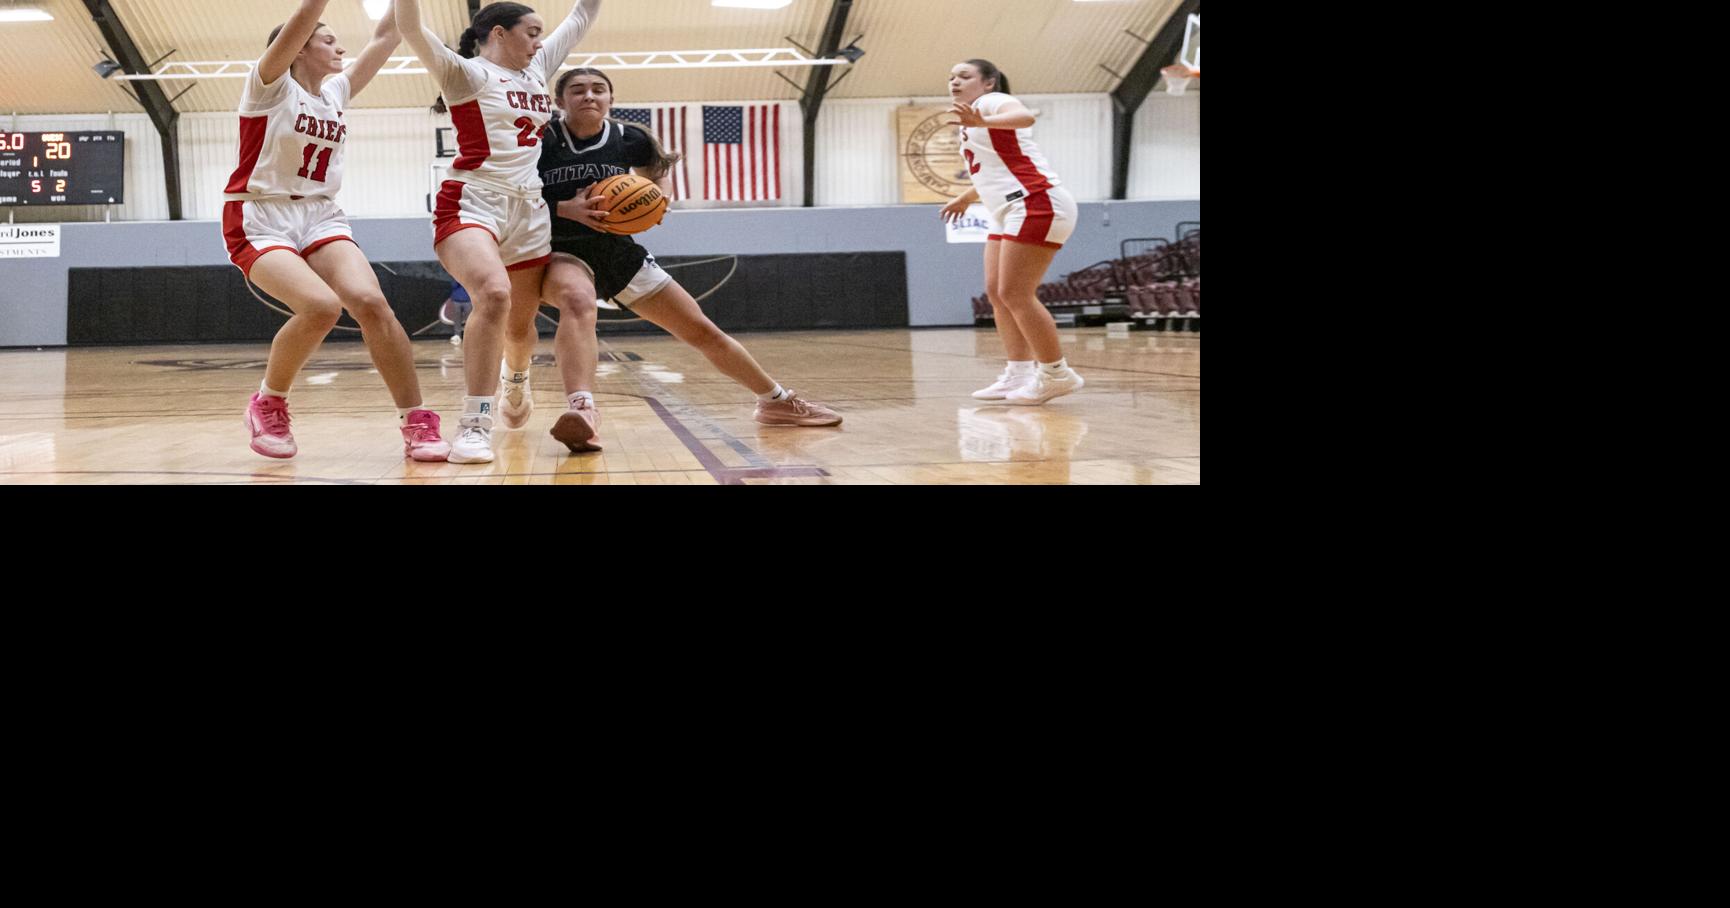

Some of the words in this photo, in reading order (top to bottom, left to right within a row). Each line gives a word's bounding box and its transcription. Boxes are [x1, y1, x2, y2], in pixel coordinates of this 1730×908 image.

[506, 91, 552, 113] CHIEF
[295, 113, 347, 144] CHIEF
[45, 142, 71, 159] 20
[297, 142, 333, 182] 11
[31, 180, 41, 192] 5
[56, 179, 66, 192] 2
[619, 187, 662, 215] Wilson
[15, 228, 55, 238] Jones
